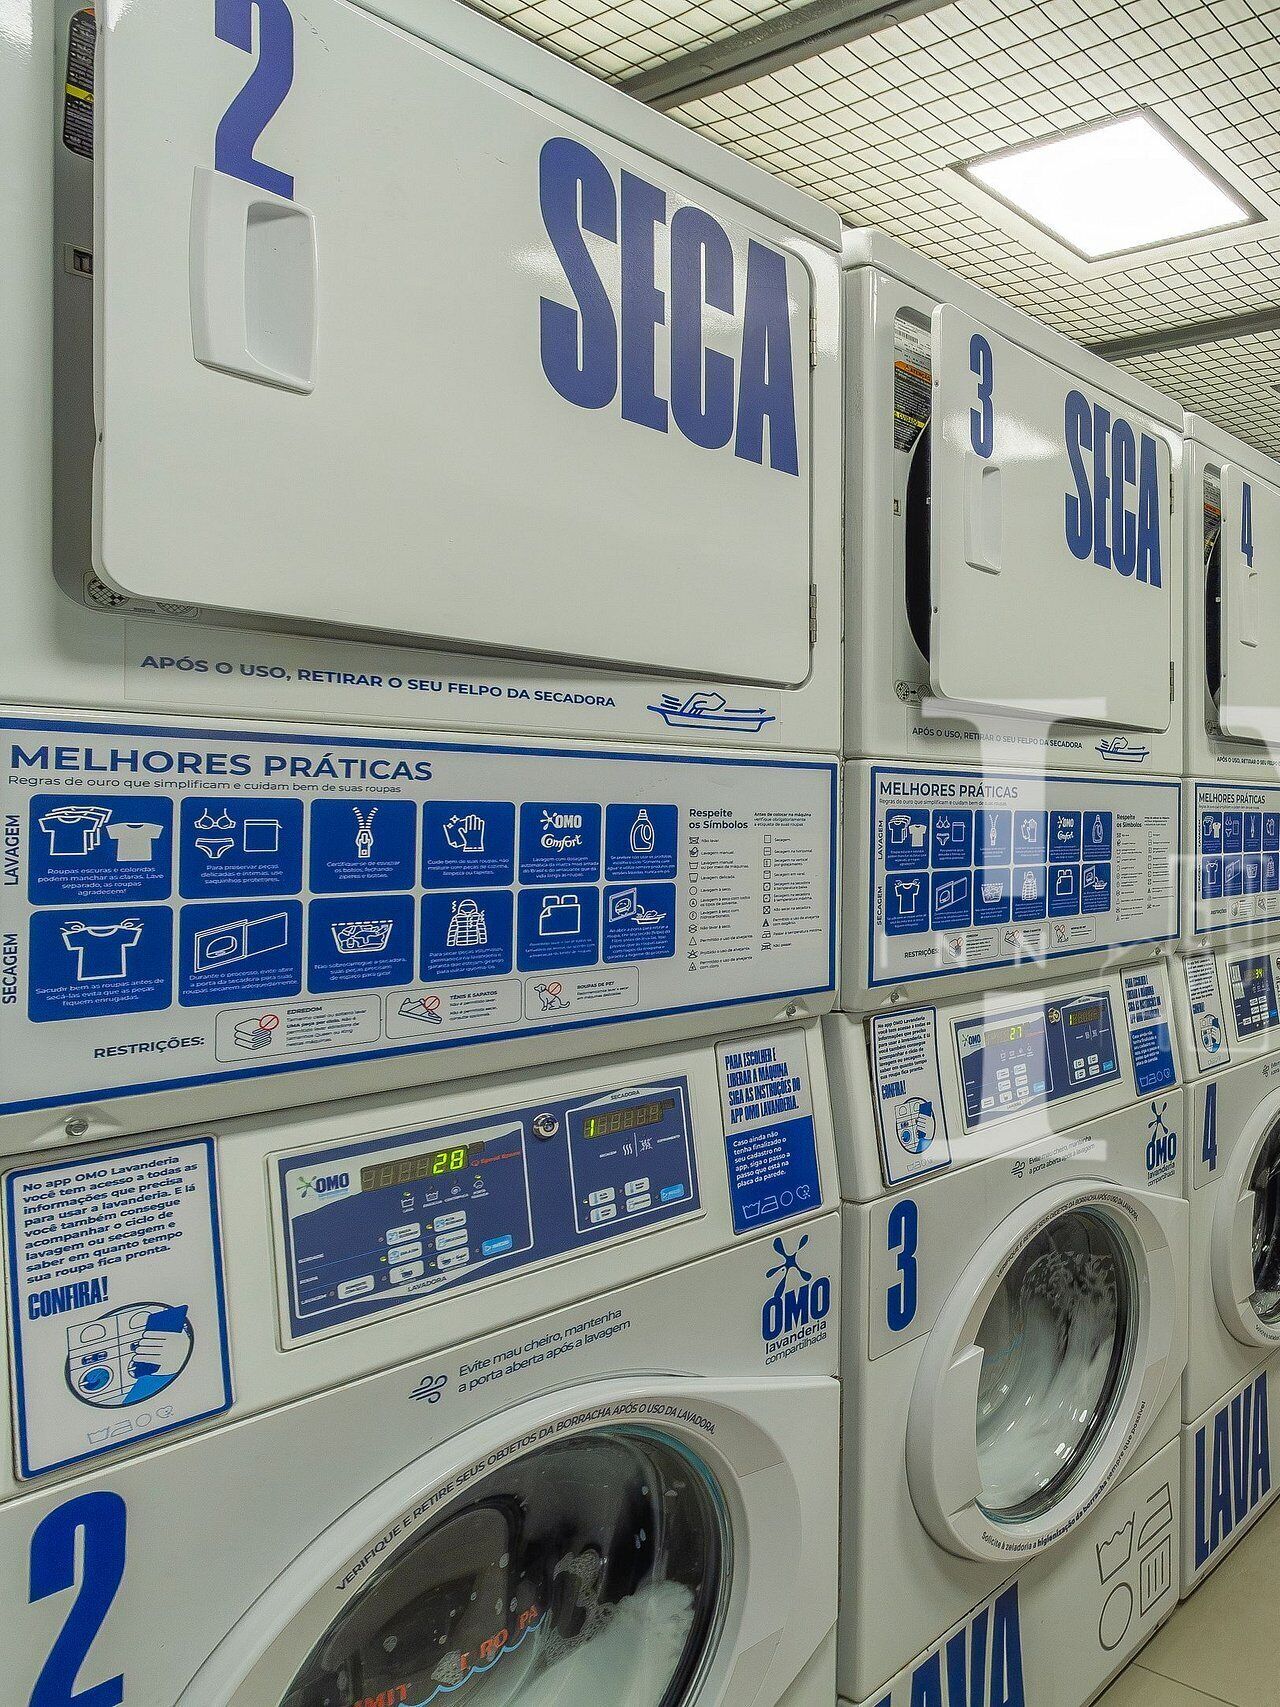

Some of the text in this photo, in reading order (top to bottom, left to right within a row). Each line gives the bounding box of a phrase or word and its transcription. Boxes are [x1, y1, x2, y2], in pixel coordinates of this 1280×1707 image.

[215, 0, 295, 201] 2
[539, 136, 800, 478] SECA
[969, 333, 994, 459] 3
[1064, 389, 1162, 589] SECA
[1241, 481, 1255, 568] 4
[140, 655, 616, 708] APÓS O USO, RETIRAR O SEU FELPO DA SECADORA
[11, 744, 433, 781] MELHORES PRÁTICAS
[8, 775, 61, 787] Regras
[64, 776, 84, 787] de
[86, 779, 120, 787] ouro
[123, 780, 151, 789] que
[153, 778, 231, 790] simplificam
[233, 782, 241, 790] e
[243, 781, 290, 791] cuidam
[292, 782, 319, 791] bem
[321, 783, 336, 792] de
[365, 786, 402, 795] roupas
[880, 781, 1019, 799] MELHORES PRÁTICAS
[1199, 792, 1266, 805] MELHORES PRÁTICAS
[555, 815, 582, 829] OMO
[689, 808, 733, 818] Respeite
[703, 820, 749, 829] Símbolos
[4, 815, 20, 886] LAVAGEM
[540, 834, 583, 852] Comfort
[2, 933, 18, 1003] SECAGEM
[93, 1036, 205, 1059] RESTRIÇÕES:
[1009, 1027, 1023, 1040] 27
[725, 1047, 777, 1070] PARA ESCOLHER E
[727, 1062, 788, 1088] LIBERAR A MÁQUINA
[729, 1077, 801, 1106] SIGA AS INSTRUÇÕES DO
[730, 1095, 799, 1124] APP OMO LAVANDERIA.
[1202, 1082, 1218, 1173] 4
[432, 1149, 465, 1176] 28
[1146, 1132, 1177, 1171] OMO
[22, 1189, 56, 1203] você
[58, 1185, 86, 1196] tem
[89, 1176, 134, 1191] acesso
[146, 1167, 182, 1179] todas
[184, 1163, 198, 1172] as
[23, 1157, 179, 1192] No app OMO Lavanderia
[315, 1172, 350, 1193] OMO
[23, 1177, 183, 1215] informações que precisa
[24, 1185, 196, 1229] para usar a lavanderia. E lá
[23, 1199, 181, 1238] você também consegue
[24, 1211, 174, 1250] acompanhar o ciclo de
[25, 1231, 183, 1273] saber em quanto tempo
[26, 1242, 85, 1261] lavagem
[87, 1237, 105, 1247] ou
[107, 1224, 166, 1242] secagem
[26, 1245, 171, 1284] sua roupa fica pronta.
[886, 1199, 918, 1332] 3
[28, 1276, 109, 1320] CONFIRA!
[762, 1276, 830, 1341] OMO
[458, 1319, 631, 1393] a porta aberta após a lavagem
[459, 1309, 622, 1377] Evite mau cheiro, mantenha
[765, 1320, 827, 1355] lavanderia
[765, 1331, 827, 1365] compartilhada
[1194, 1369, 1271, 1571] LAVA
[336, 1402, 716, 1591] VERIFIQUE E RETIRE SEUS OBJETOS DA BORRACHA APÓS O USO DA LAVADORA.
[29, 1490, 127, 1707] 2
